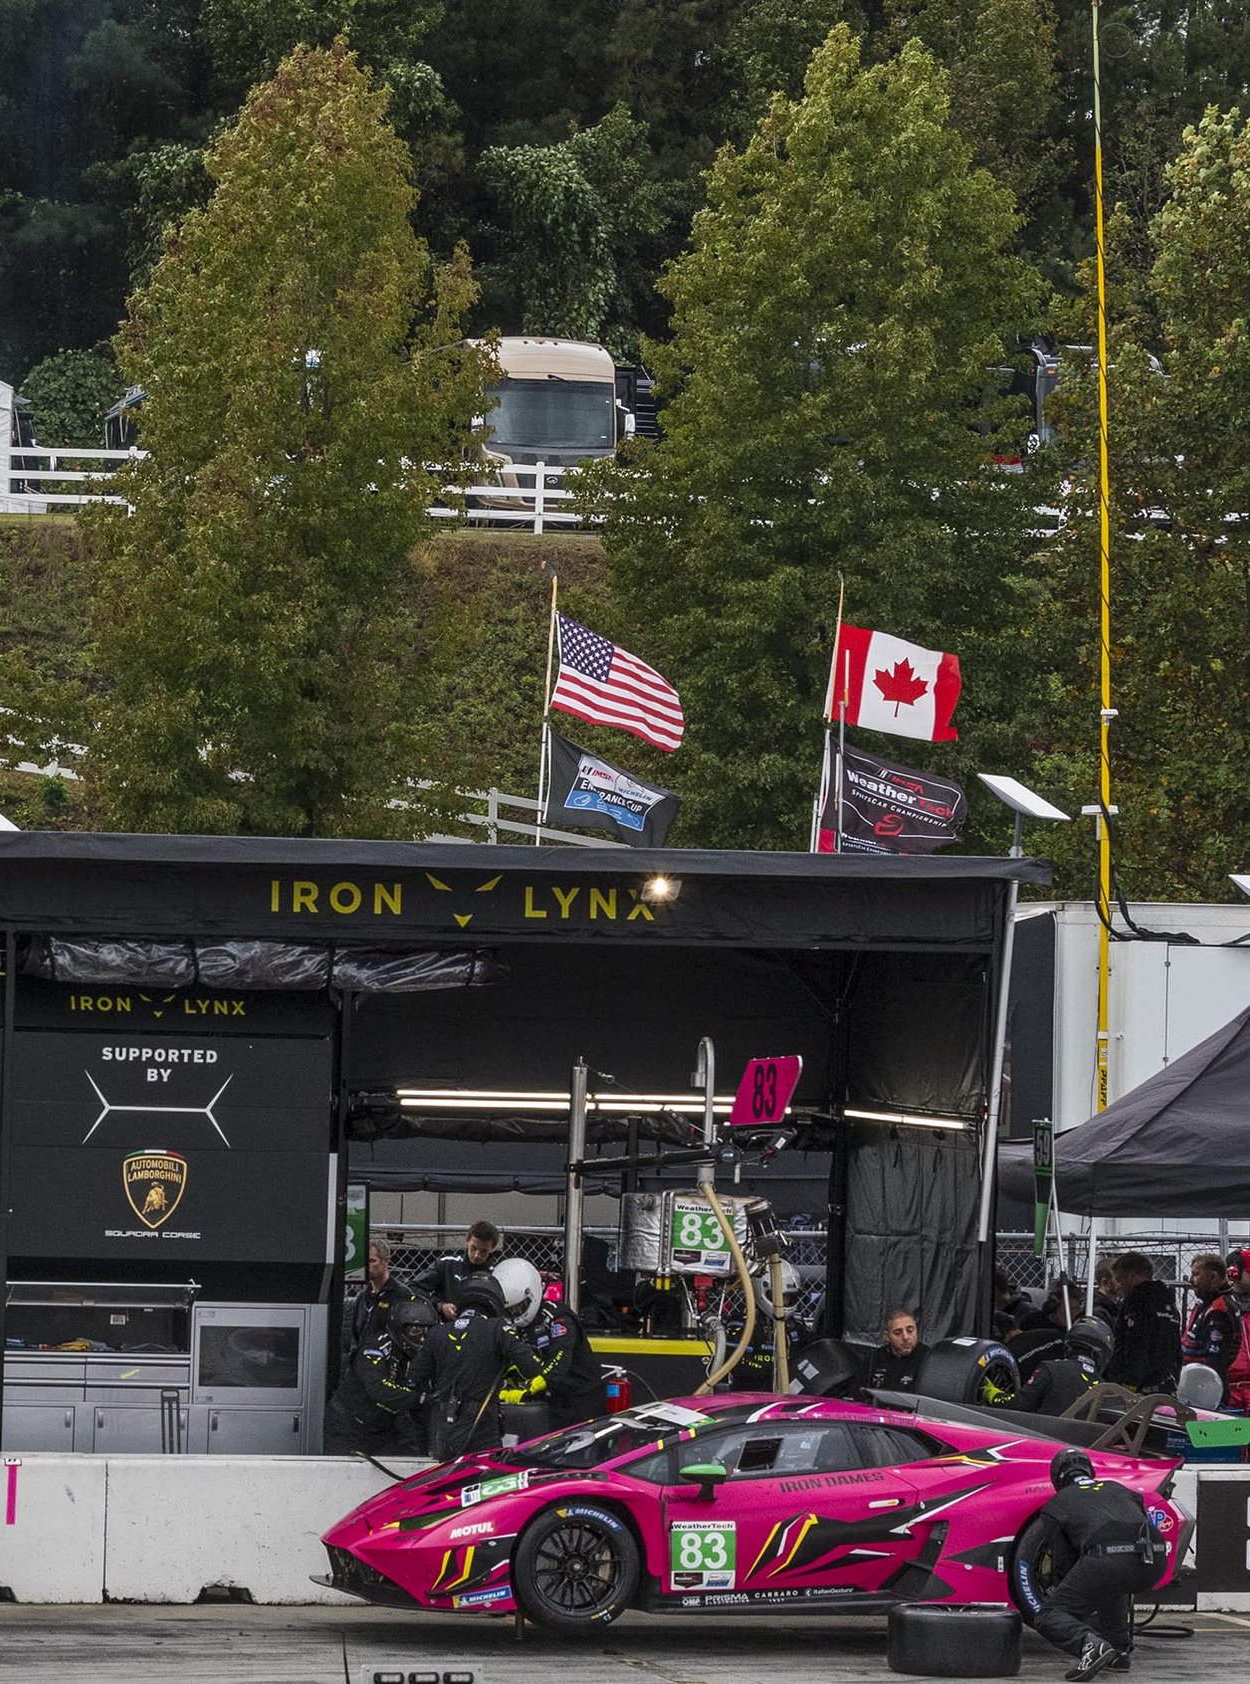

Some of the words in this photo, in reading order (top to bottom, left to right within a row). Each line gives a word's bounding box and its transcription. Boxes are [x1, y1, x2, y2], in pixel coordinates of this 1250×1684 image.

[626, 801, 643, 813] CUP
[270, 880, 402, 915] IRON
[524, 886, 655, 922] LYNX
[70, 996, 131, 1012] IRON
[184, 1000, 246, 1016] LYNX
[101, 1047, 218, 1063] SUPPORTED
[146, 1068, 172, 1082] BY
[752, 1063, 778, 1118] 83
[130, 1160, 179, 1172] AUTOMOBILI
[127, 1171, 182, 1184] LAMBORGHINI
[104, 1230, 159, 1238] SQUADRA
[162, 1231, 202, 1239] CORSE
[680, 1213, 725, 1250] 83
[779, 1479, 823, 1493] IRON
[825, 1471, 884, 1488] DAMES
[575, 1507, 618, 1529] MICHELIN
[450, 1521, 495, 1540] MOTUL
[673, 1522, 733, 1530] WeatherTech
[680, 1531, 728, 1570] 83
[469, 1590, 506, 1602] MICHELIN
[705, 1593, 750, 1601] PRISMA
[754, 1590, 798, 1599] CARRARO
